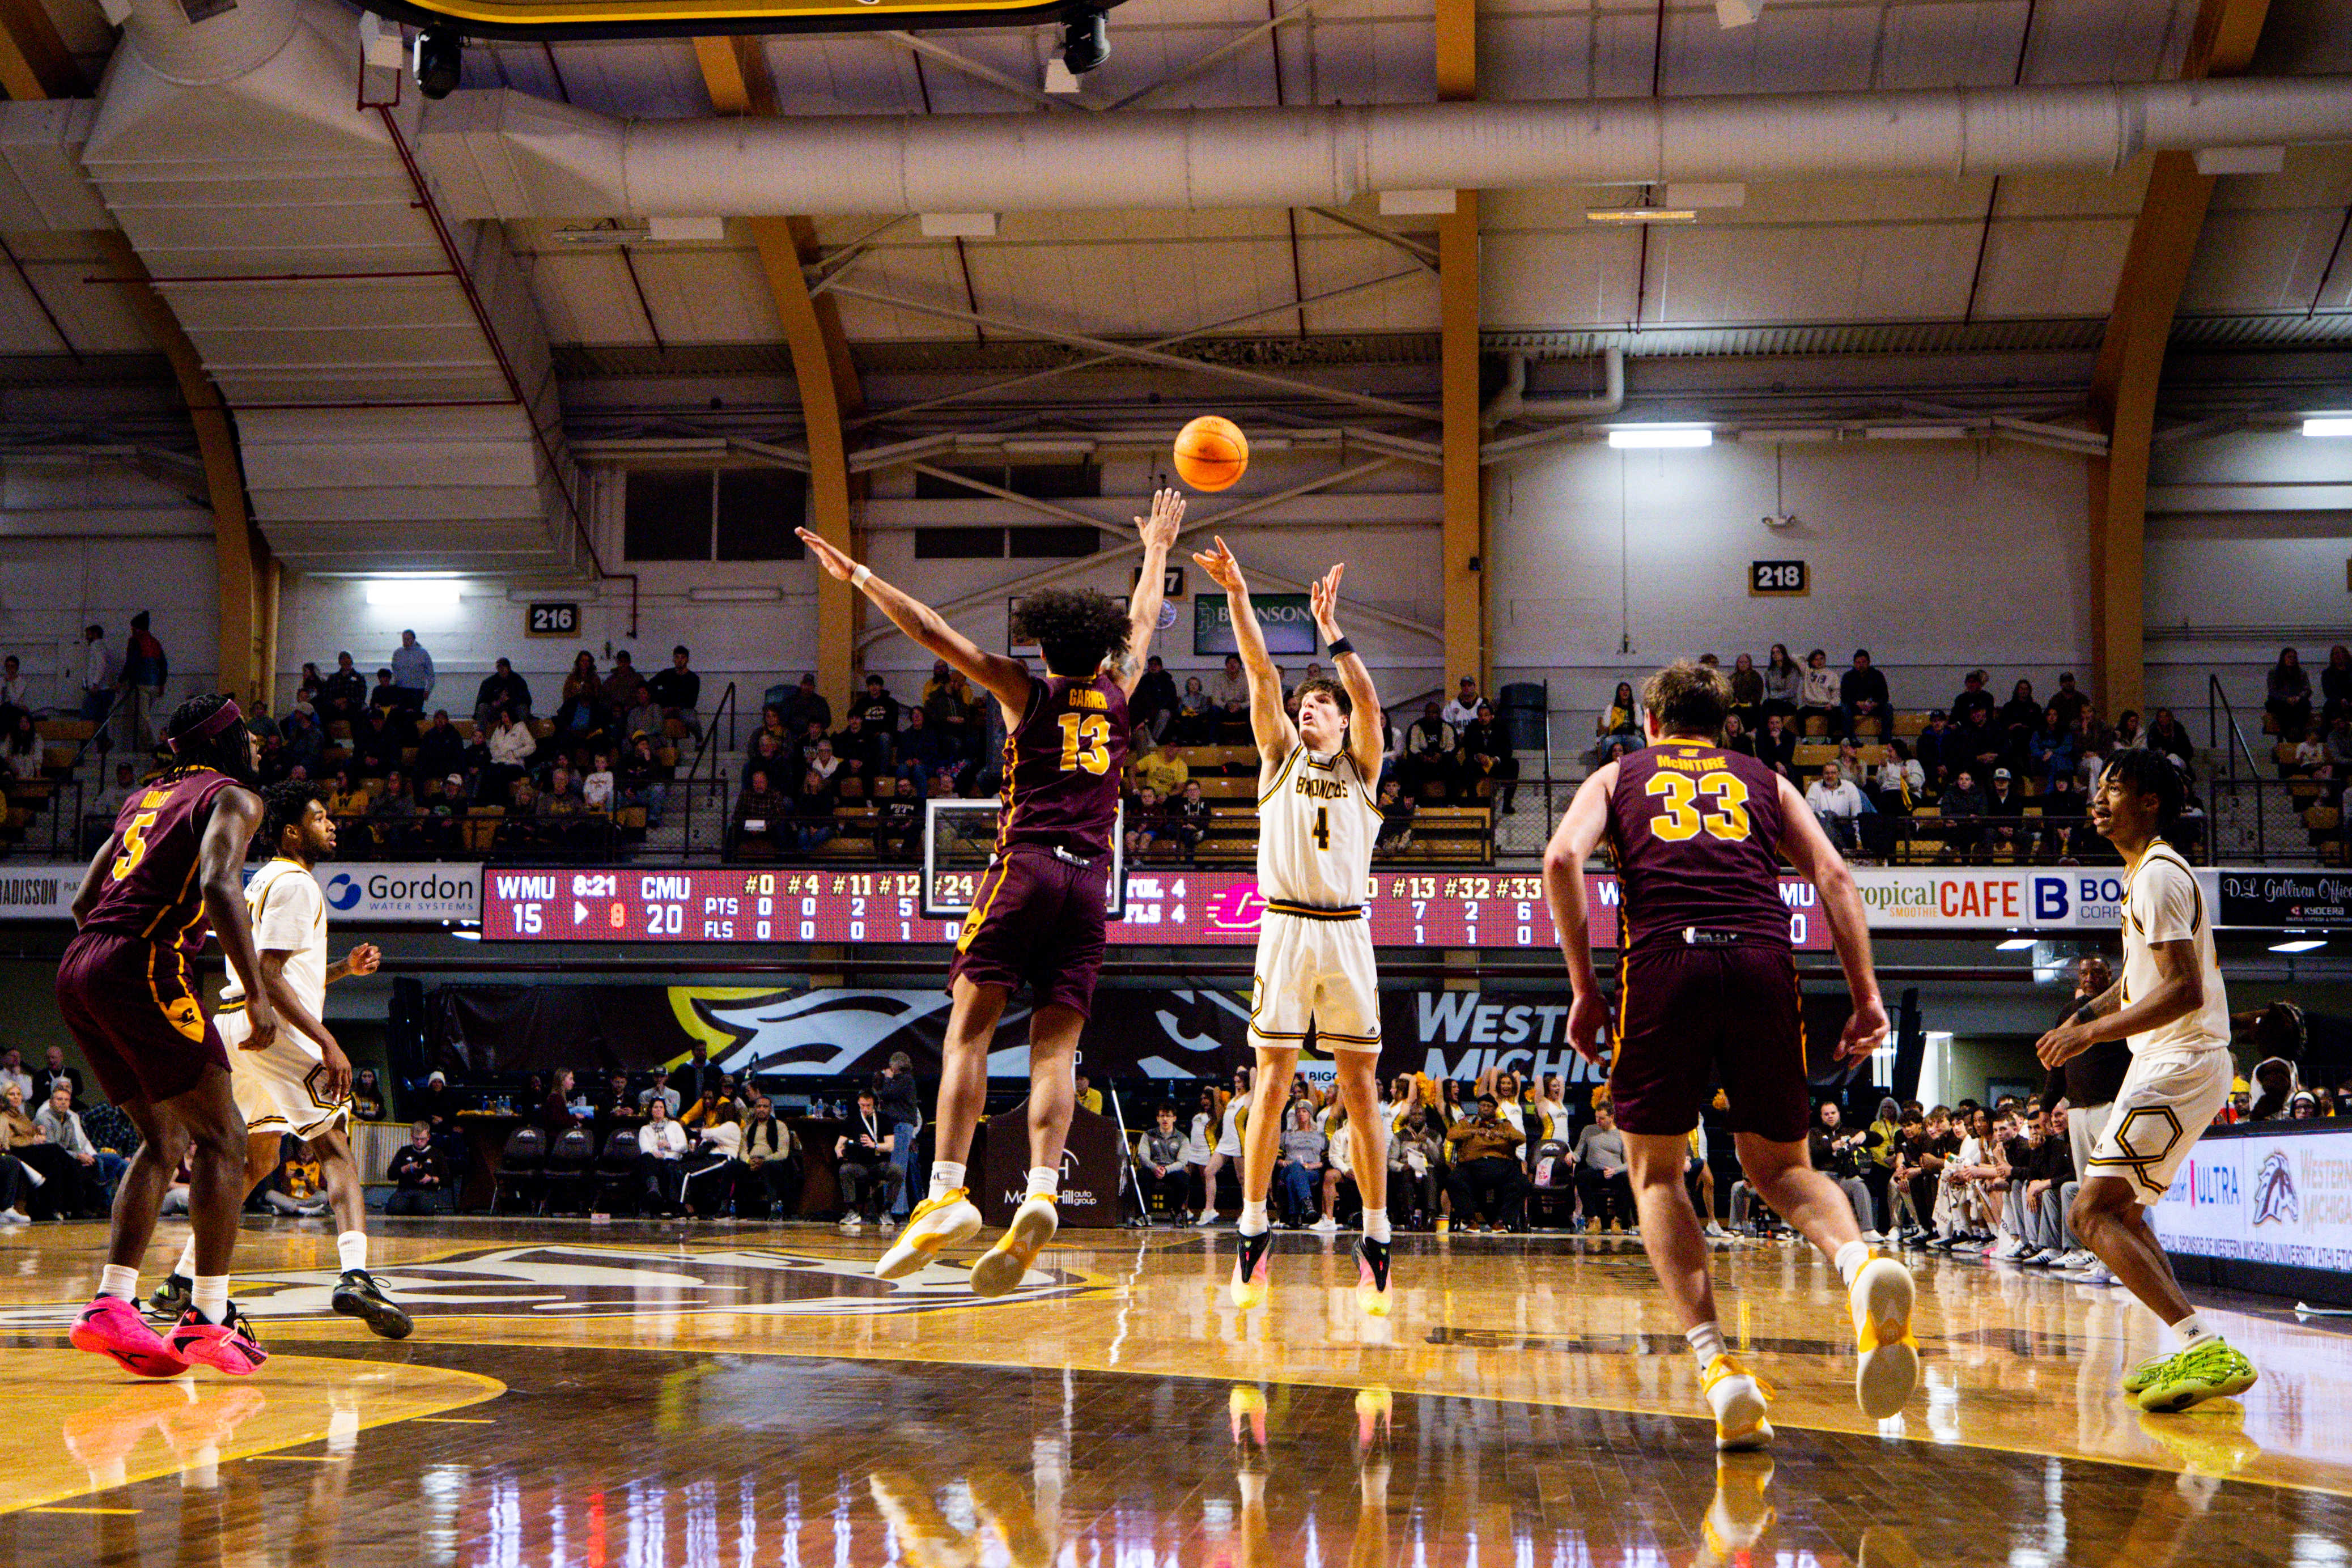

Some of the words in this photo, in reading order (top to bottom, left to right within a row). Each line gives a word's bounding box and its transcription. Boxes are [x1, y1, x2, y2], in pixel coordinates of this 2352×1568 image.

[1758, 566, 1799, 587] 218
[534, 609, 572, 628] 216
[1219, 606, 1311, 622] BNSON
[1069, 688, 1107, 709] GARNER
[1058, 712, 1111, 776] 13
[1656, 754, 1728, 771] McINTIRE
[1296, 775, 1348, 800] BRONCOS
[1645, 771, 1751, 843] 33
[1311, 805, 1330, 851] 4
[112, 811, 158, 882] 5
[0, 879, 57, 905] ADISSON
[368, 873, 473, 899] Gordon
[496, 876, 555, 899] WMU
[572, 875, 616, 896] 8:21
[641, 877, 691, 900] CMU
[745, 874, 775, 895] #0
[788, 874, 820, 895] #4
[832, 874, 872, 896] #11
[878, 875, 920, 896] #12
[1171, 878, 1186, 898] 4
[1391, 878, 1436, 898] #13
[1444, 878, 1490, 899] #32
[1496, 878, 1542, 899] #33
[1778, 883, 1814, 907] MU
[1857, 881, 1938, 910] ropical
[2080, 878, 2121, 902] BO
[2265, 878, 2315, 902] Gallivan
[418, 902, 474, 911] SYSTEMS
[704, 897, 738, 916] PTS
[758, 897, 772, 916] 0
[801, 898, 816, 916] 0
[851, 898, 865, 917] 2
[898, 898, 912, 917] 5
[1941, 881, 2019, 917] CAFE
[2035, 877, 2069, 920] B
[512, 903, 542, 933] 15
[646, 904, 683, 934] 20
[1123, 903, 1161, 923] FLS
[1171, 903, 1186, 923] 4
[1411, 901, 1427, 920] 7
[1464, 901, 1479, 920] 2
[1517, 902, 1531, 921] 6
[1890, 907, 1938, 918] SMOOTHIE
[2081, 906, 2121, 919] CORP
[704, 920, 734, 939] FLS
[757, 921, 771, 940] 0
[800, 921, 814, 940] 0
[850, 921, 864, 940] 0
[900, 921, 910, 940] 1
[945, 921, 960, 941] 0
[1413, 925, 1425, 944] 1
[1466, 925, 1477, 945] 1
[1517, 925, 1532, 945] 0
[1790, 913, 1806, 944] 0
[1419, 992, 1571, 1043] WEST
[1424, 1048, 1614, 1082] MICHIG
[2197, 1166, 2240, 1205] ULTRA
[2303, 1195, 2352, 1234] MICHIGA
[2159, 1233, 2177, 1252] FFICIAL
[2179, 1234, 2204, 1255] SPONSOR
[2205, 1237, 2213, 1255] OF
[2214, 1238, 2242, 1259] WESTERN
[2243, 1240, 2274, 1263] MICHIGAN
[2275, 1243, 2316, 1268] UNIVERSITY
[2318, 1247, 2352, 1272] ATHLETIC
